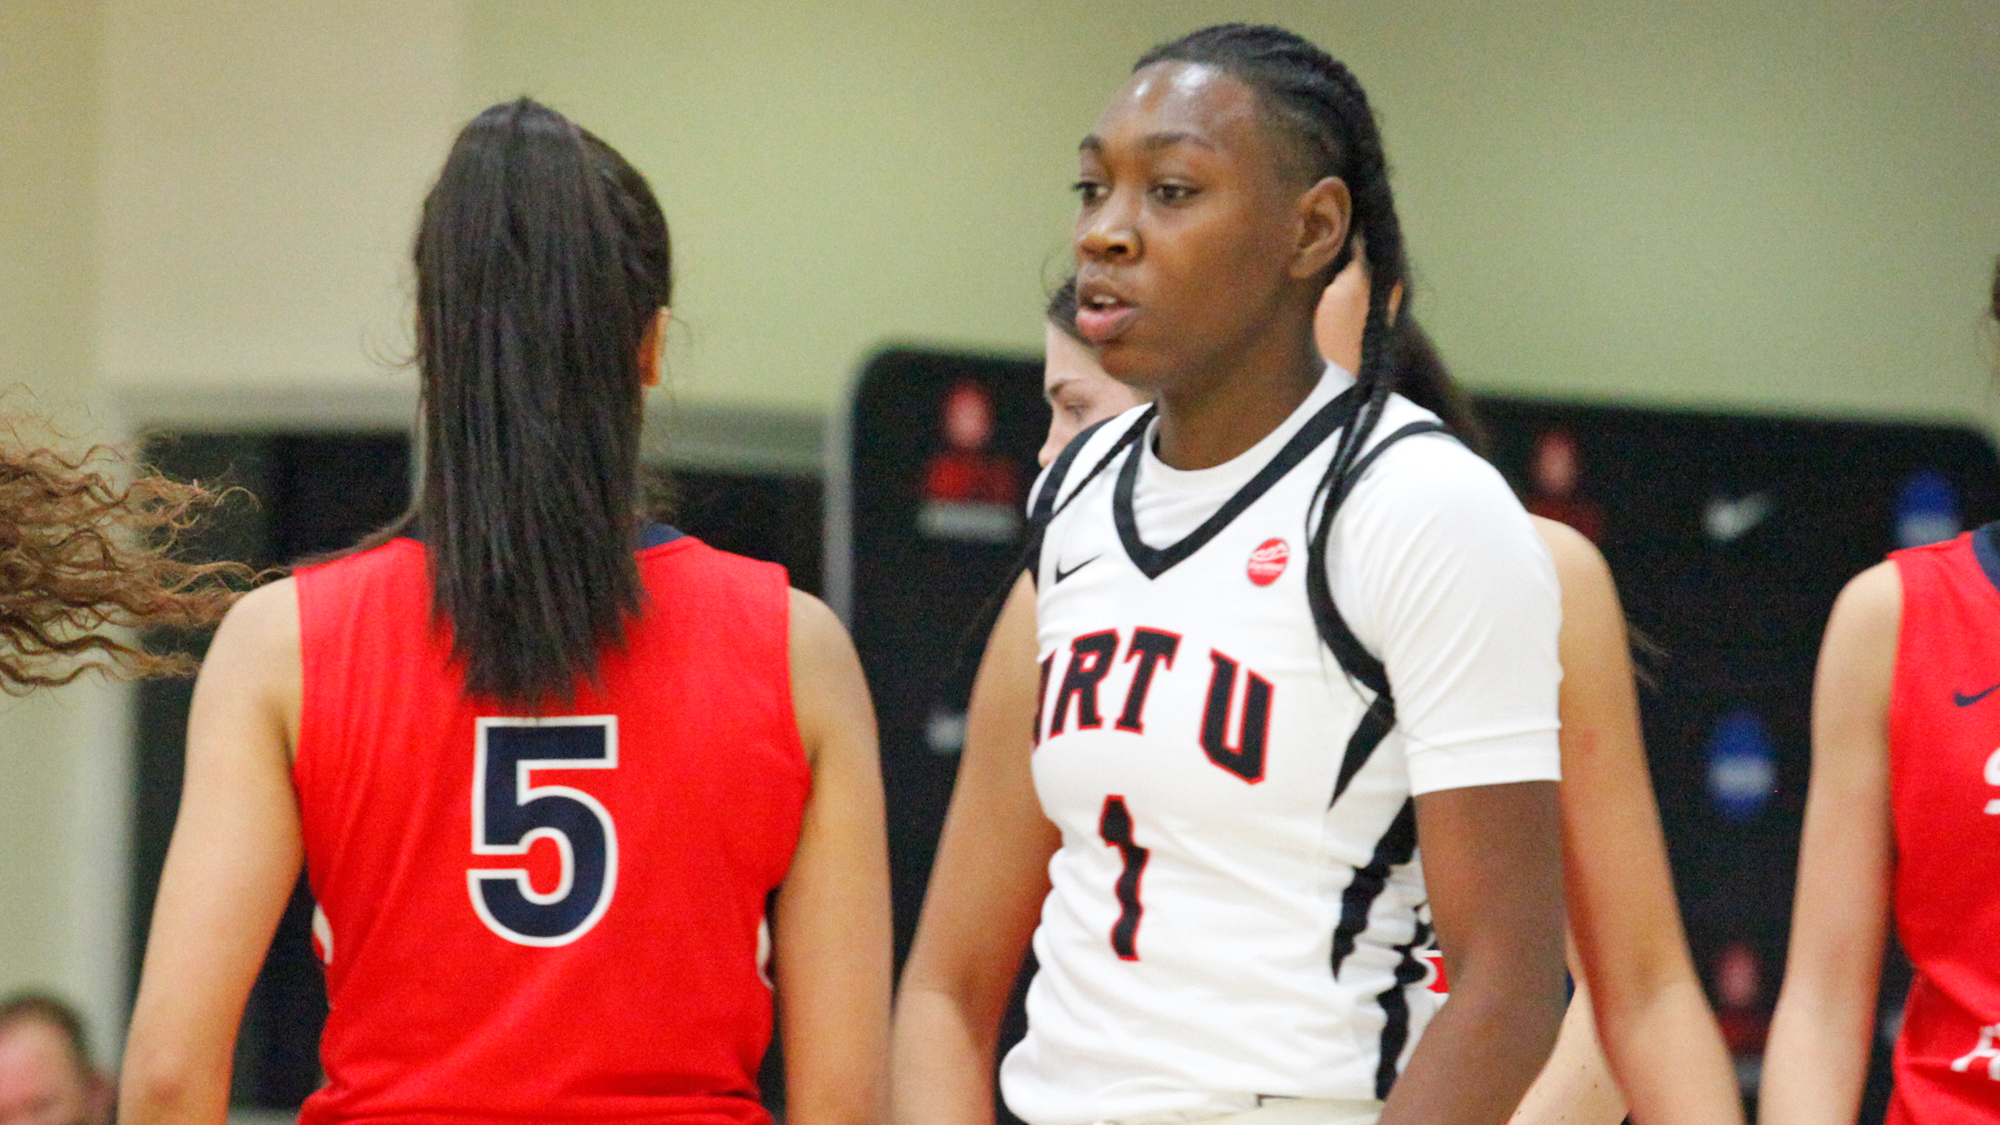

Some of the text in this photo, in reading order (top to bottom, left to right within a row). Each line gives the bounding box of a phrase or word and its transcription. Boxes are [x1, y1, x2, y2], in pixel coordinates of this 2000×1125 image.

[1198, 648, 1275, 785] U
[466, 714, 618, 948] 5
[1099, 794, 1150, 961] 1
